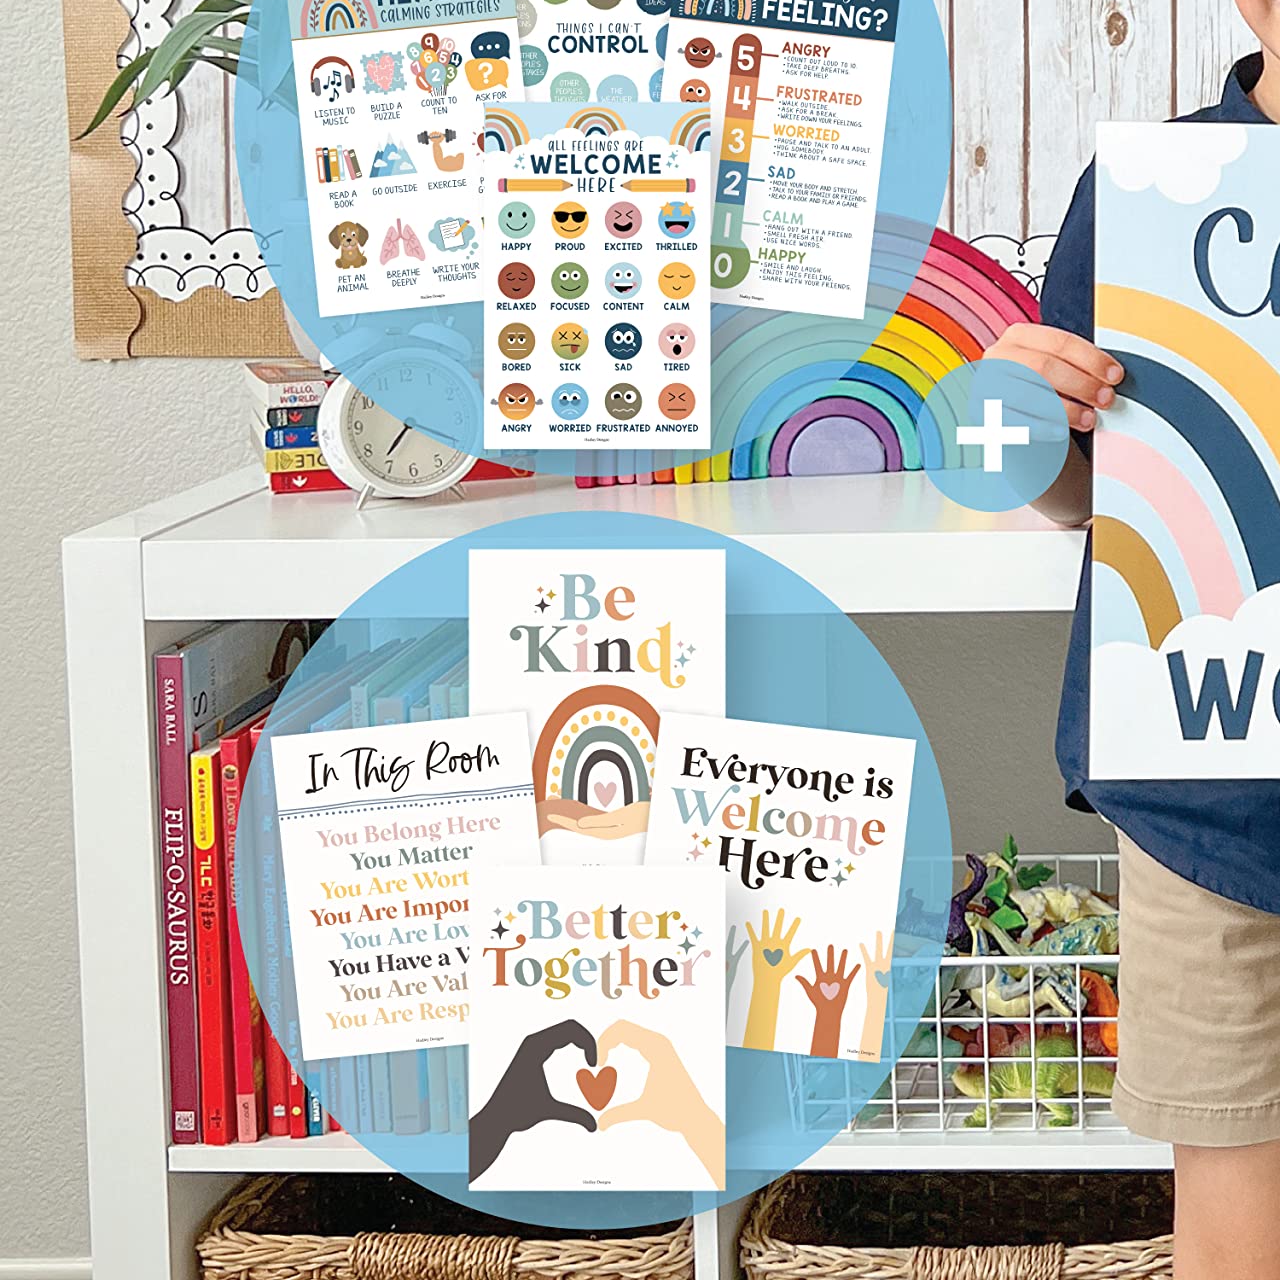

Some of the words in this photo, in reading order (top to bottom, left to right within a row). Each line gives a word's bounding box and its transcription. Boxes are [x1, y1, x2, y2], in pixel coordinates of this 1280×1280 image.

[163, 678, 176, 713] SARA
[165, 714, 178, 746] BALL
[165, 808, 188, 986] FLIP-O-SAURUS
